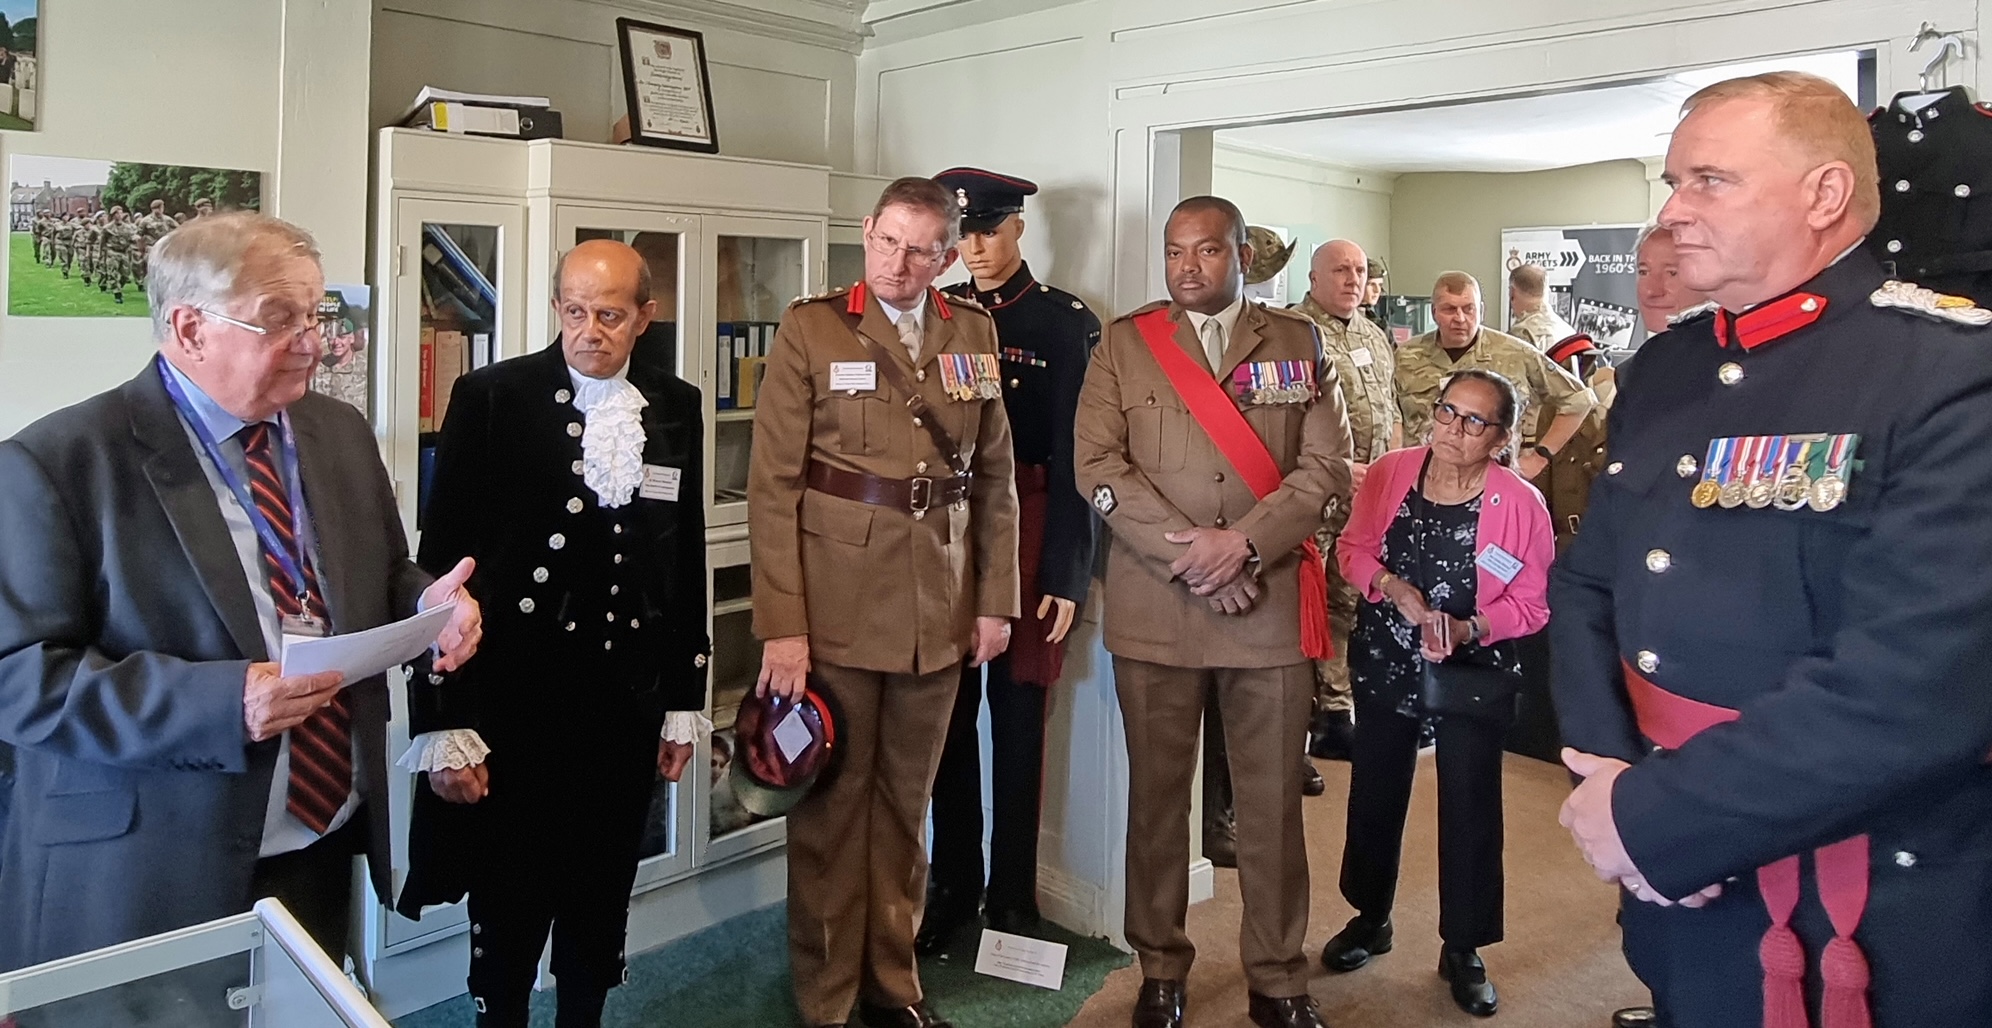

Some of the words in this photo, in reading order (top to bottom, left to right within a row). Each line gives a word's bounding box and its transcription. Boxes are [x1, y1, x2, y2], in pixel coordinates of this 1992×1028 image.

[1525, 251, 1551, 260] ARMY
[1588, 254, 1611, 263] BACK
[1612, 254, 1623, 263] IN
[1624, 254, 1636, 263] TH
